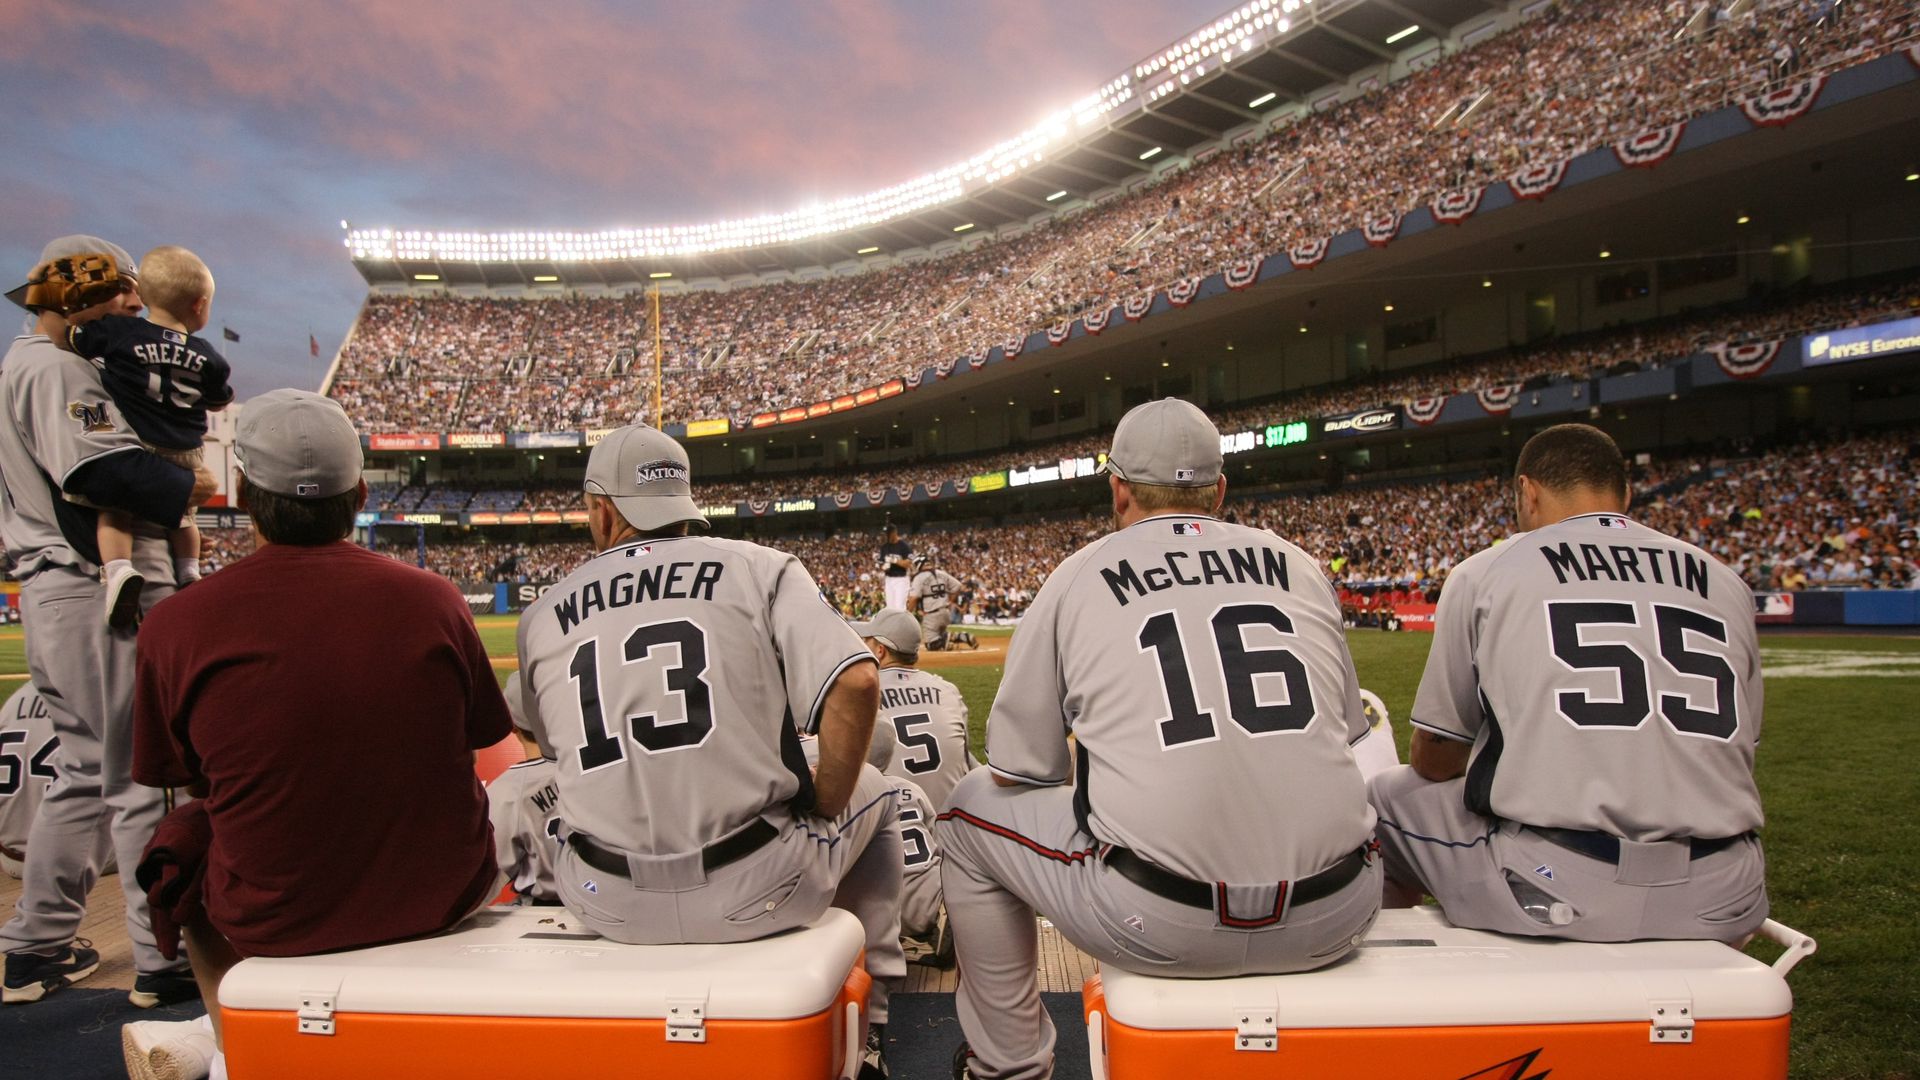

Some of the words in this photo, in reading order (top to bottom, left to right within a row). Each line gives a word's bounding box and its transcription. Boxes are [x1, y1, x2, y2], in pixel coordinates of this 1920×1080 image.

[134, 343, 208, 373] SHEETS
[1829, 341, 1870, 359] NYSE
[145, 366, 203, 409] 15
[451, 434, 502, 445] MODELL'S
[1324, 420, 1352, 432] BUD
[1357, 412, 1396, 427] LIGHT
[710, 505, 736, 516] Locker
[782, 500, 816, 512] MetLife
[1100, 546, 1290, 607] McCANN
[1539, 542, 1709, 600] MARTIN
[554, 561, 724, 636] WAGNER
[1135, 603, 1319, 752] 16
[1543, 599, 1739, 743] 55
[568, 617, 717, 776] 13
[891, 712, 942, 776] 5
[531, 783, 560, 813] WA
